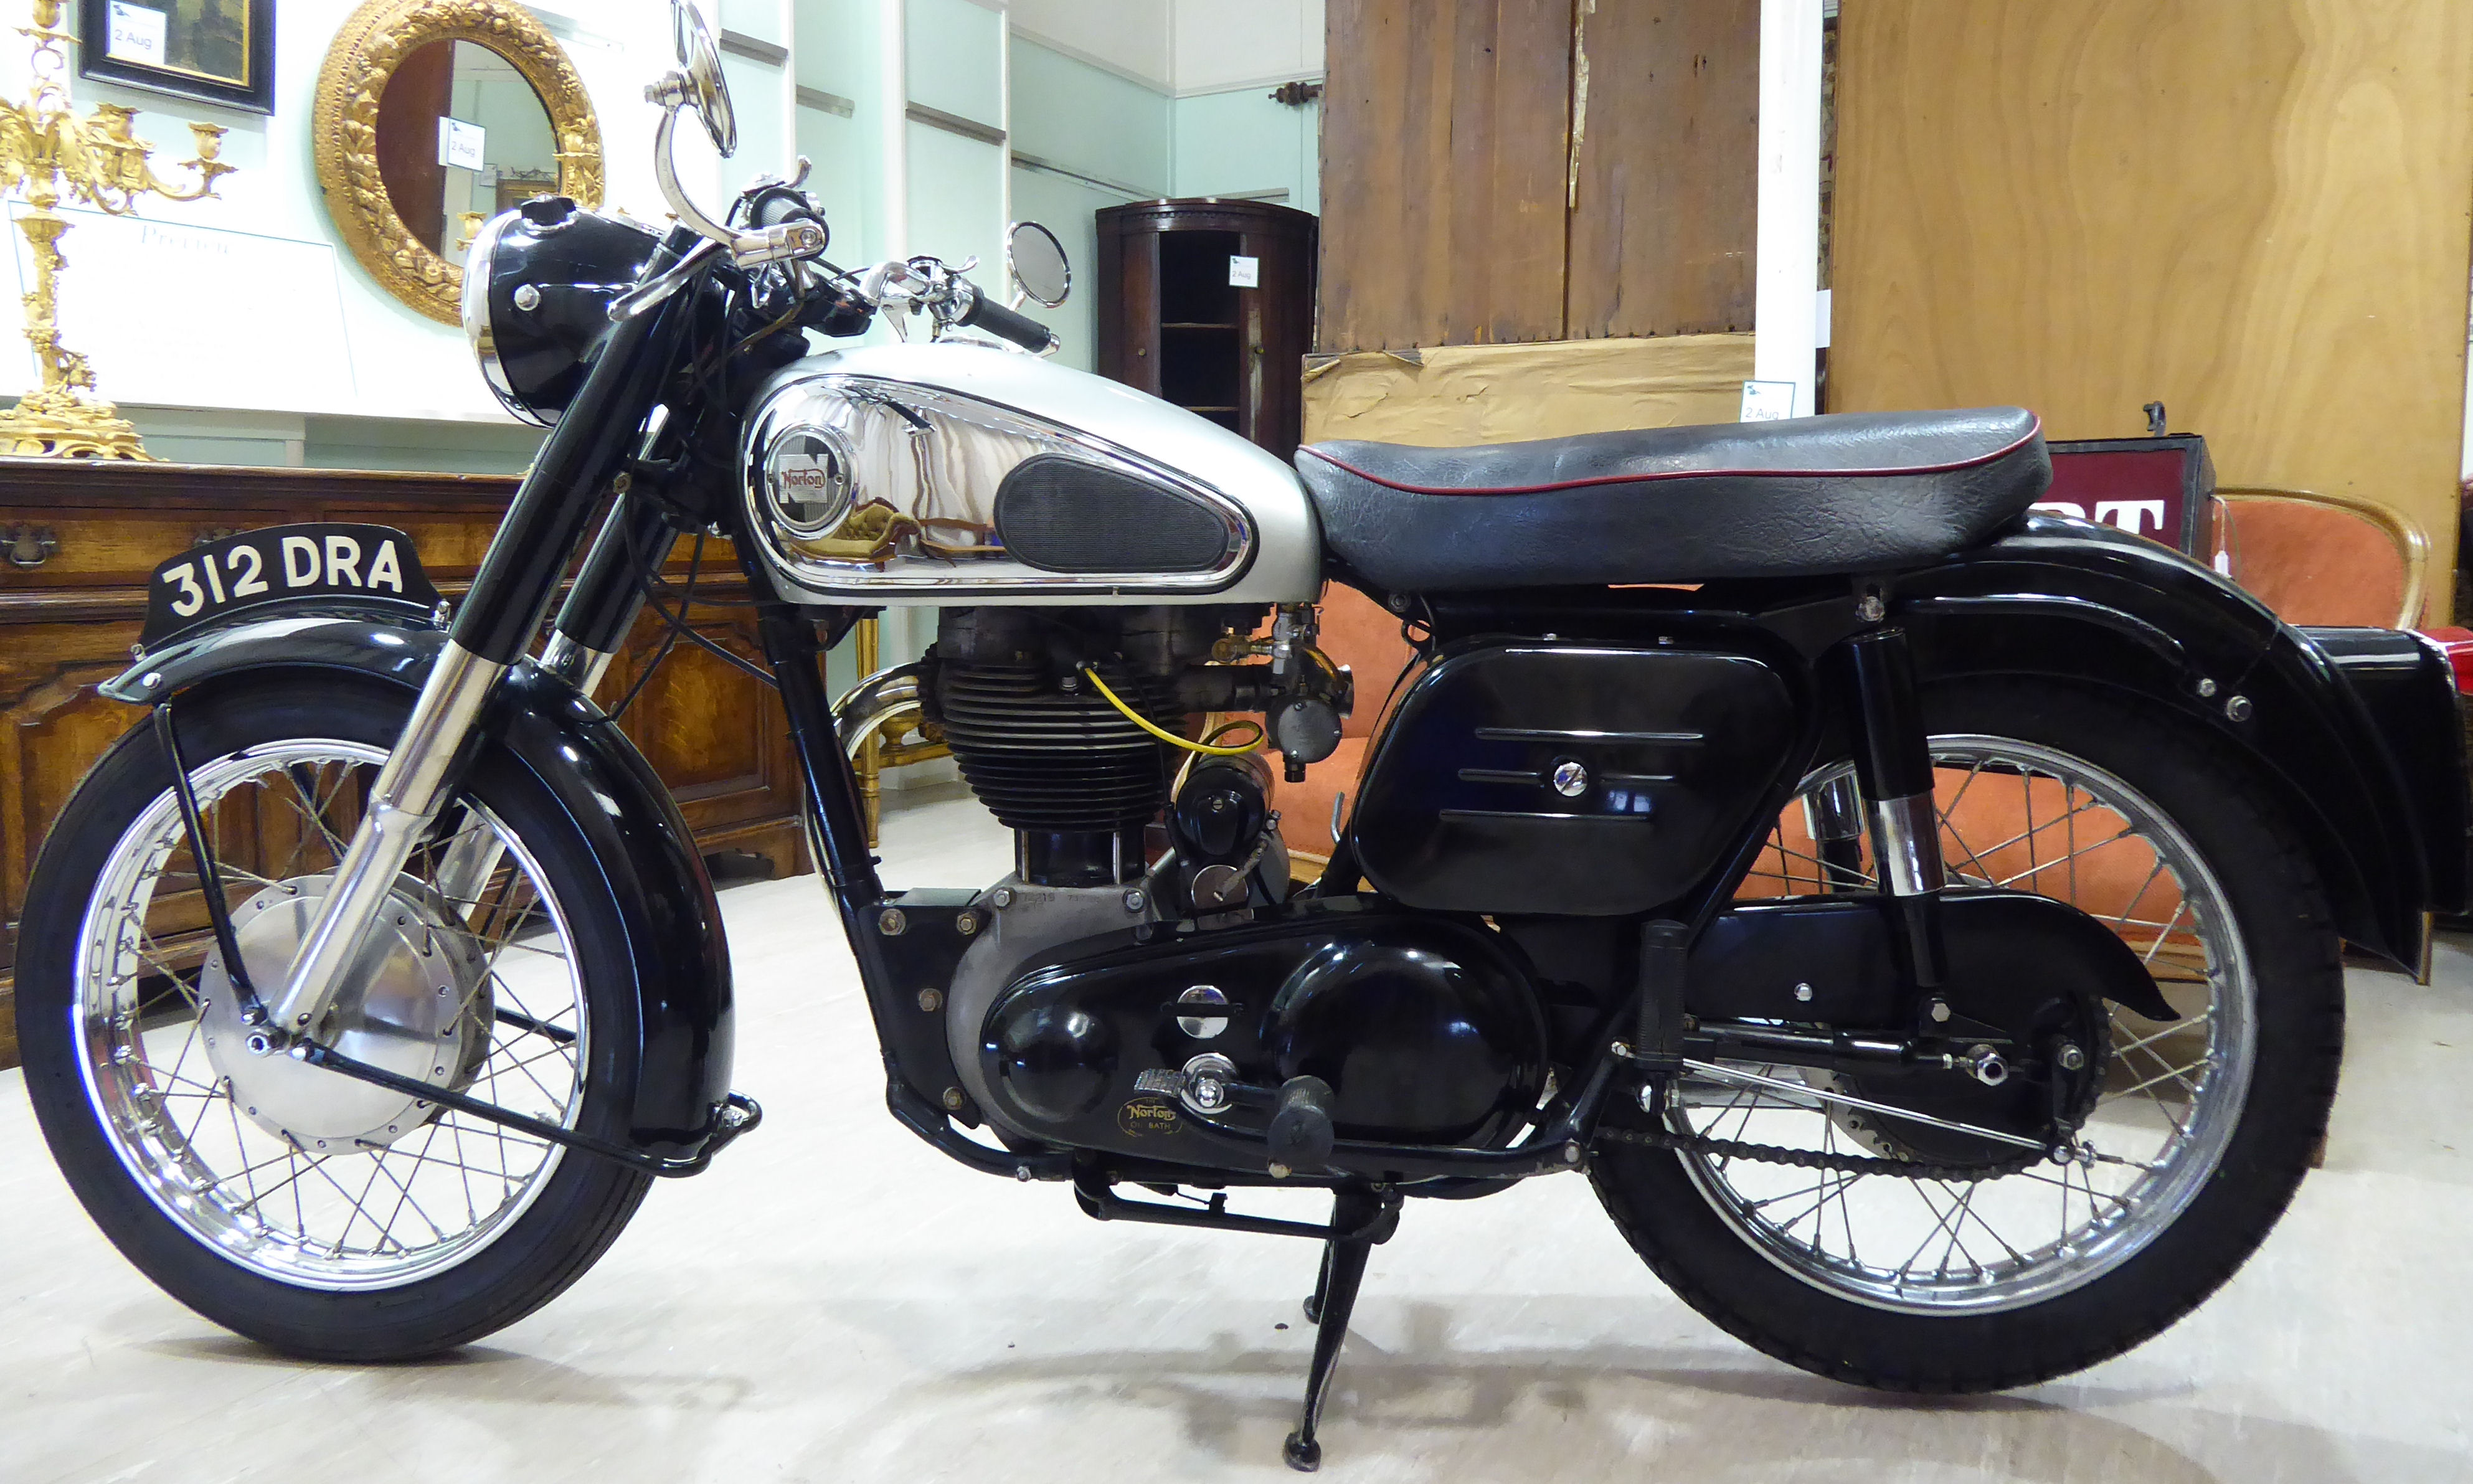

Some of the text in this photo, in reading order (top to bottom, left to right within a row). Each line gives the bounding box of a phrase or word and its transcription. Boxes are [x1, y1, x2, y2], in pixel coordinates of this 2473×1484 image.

[115, 29, 152, 50] 2 Aug
[452, 141, 476, 158] 2 Aug
[1238, 271, 1251, 280] Aug
[1746, 407, 1753, 418] 2
[781, 468, 826, 489] Norton
[161, 536, 403, 617] 312 DRA
[1127, 1104, 1176, 1121] Norton
